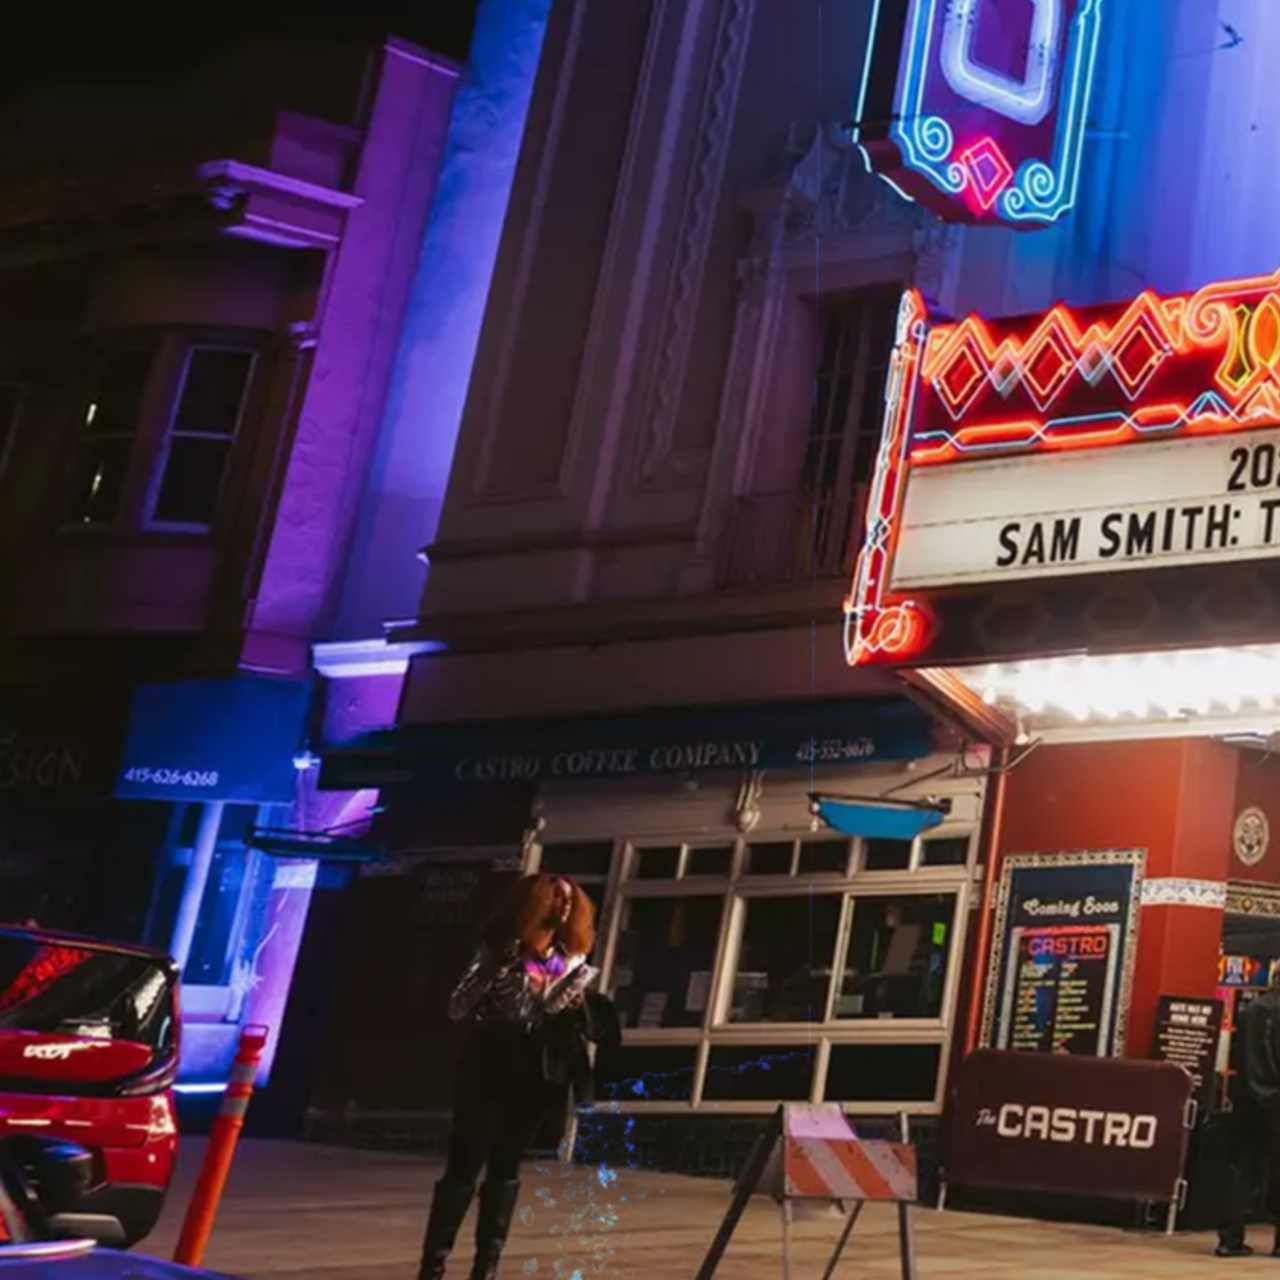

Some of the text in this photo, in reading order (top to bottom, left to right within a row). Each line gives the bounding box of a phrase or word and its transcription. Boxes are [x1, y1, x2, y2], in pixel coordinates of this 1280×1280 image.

[996, 518, 1081, 567] SAM
[1098, 502, 1241, 558] SMITH:
[123, 766, 220, 789] 415-626-6268
[454, 741, 765, 782] CASTRO COFFEE COMPANY
[1022, 895, 1119, 918] Coming Soon
[1028, 935, 1107, 956] CASTRO
[997, 1103, 1158, 1149] CASTRO
